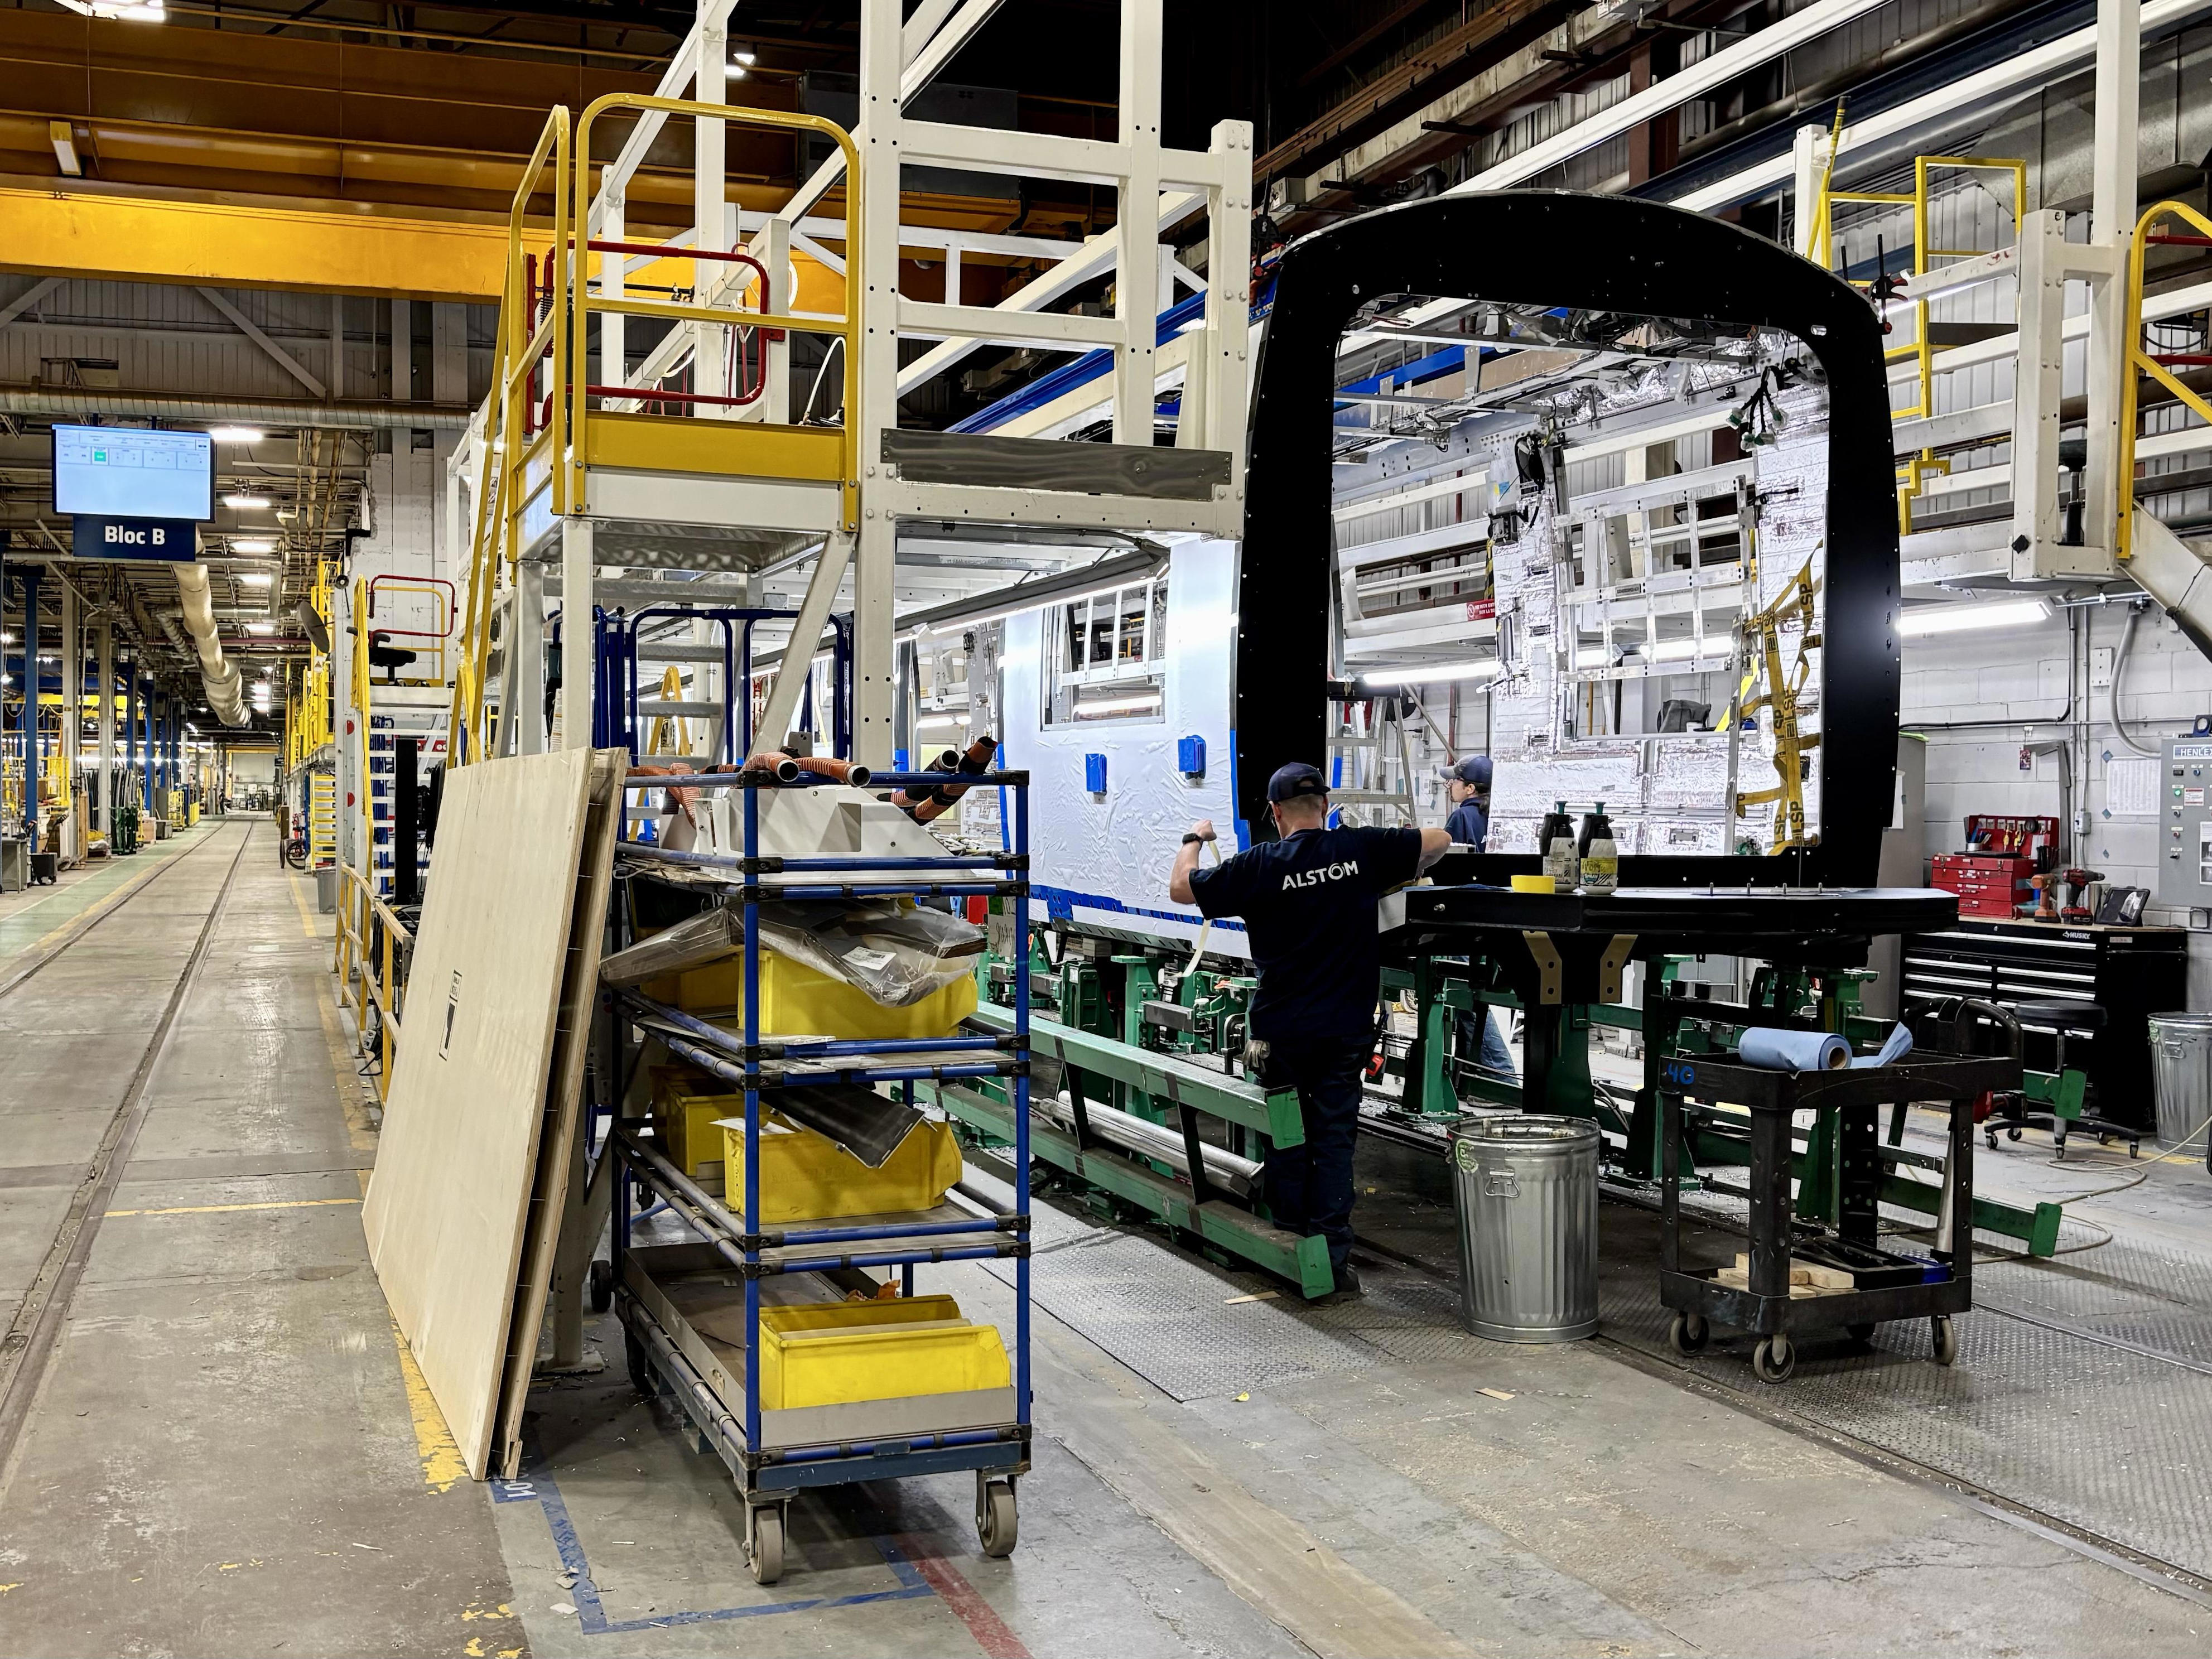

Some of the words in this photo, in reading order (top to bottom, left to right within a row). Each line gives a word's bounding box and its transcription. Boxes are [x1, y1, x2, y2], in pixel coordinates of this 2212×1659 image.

[105, 525, 146, 544] Bloc
[152, 528, 165, 545] B
[1791, 801, 1804, 833] LSP
[1283, 860, 1358, 890] ALSTOM
[1668, 1062, 1694, 1085] 40
